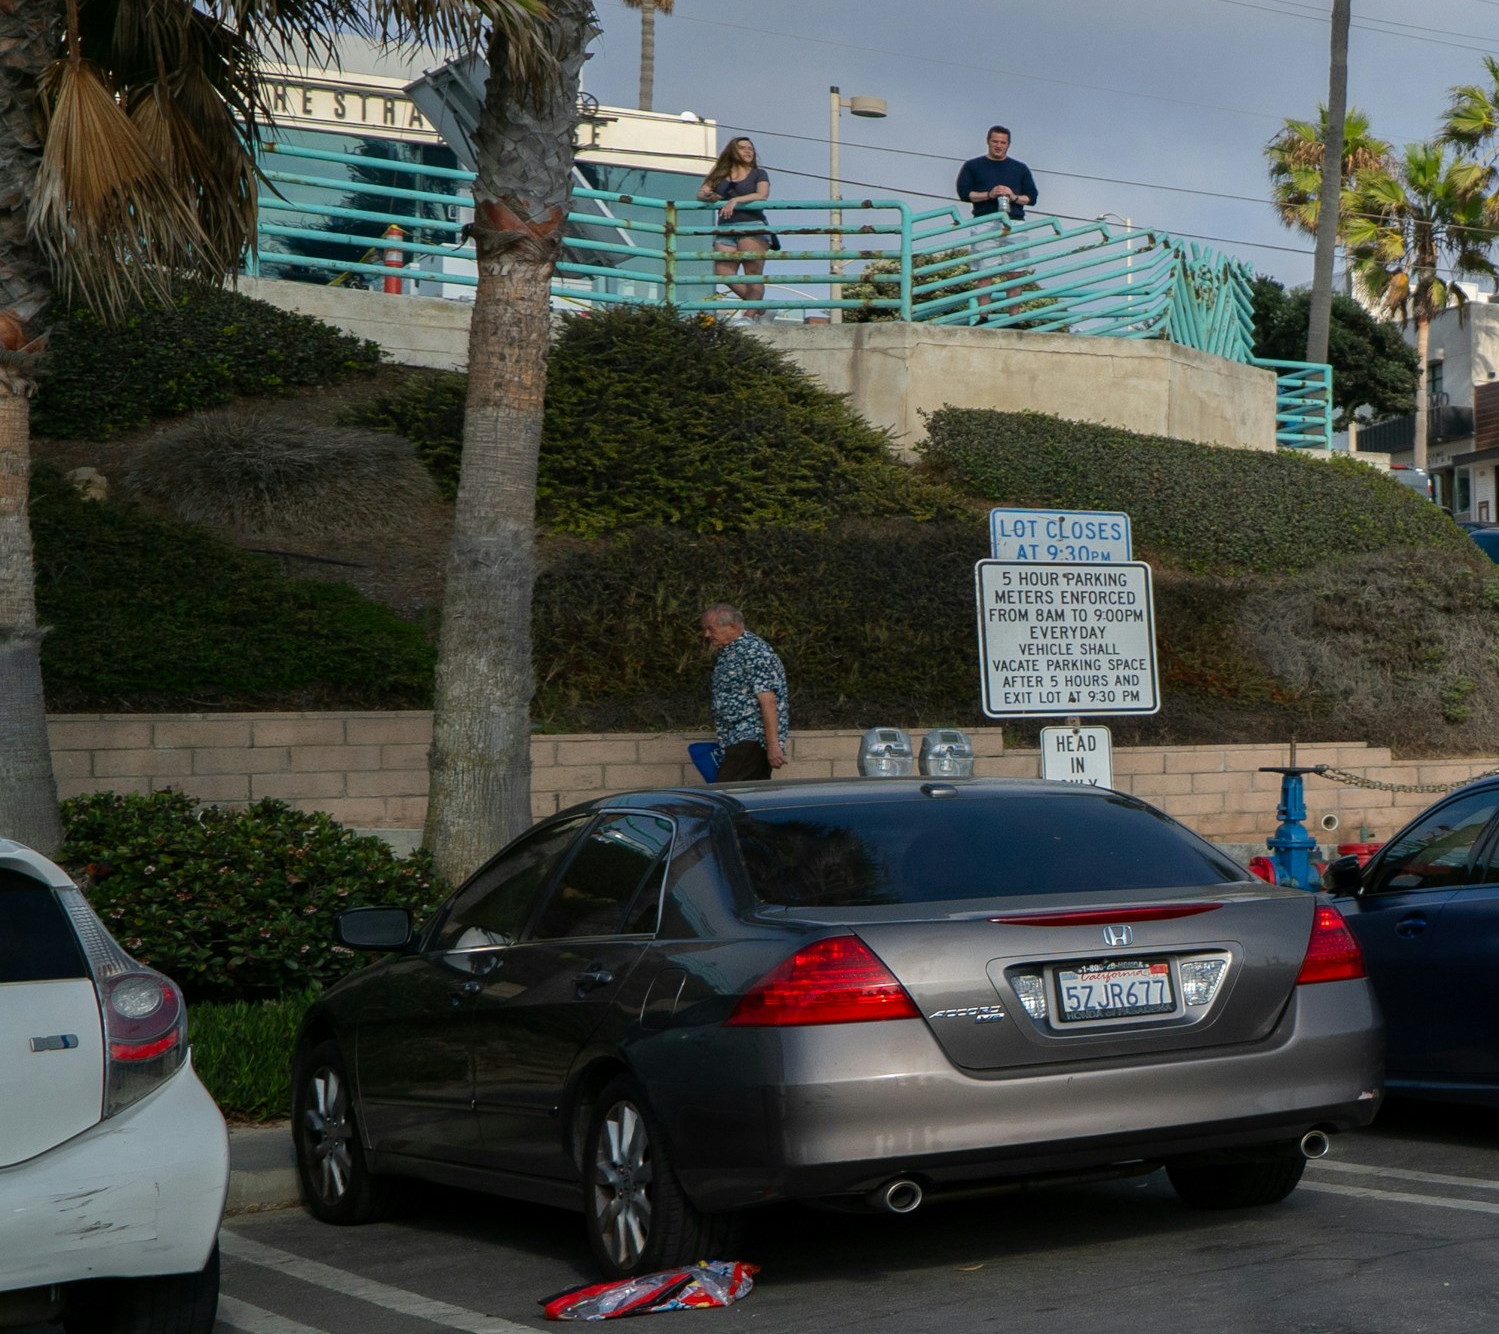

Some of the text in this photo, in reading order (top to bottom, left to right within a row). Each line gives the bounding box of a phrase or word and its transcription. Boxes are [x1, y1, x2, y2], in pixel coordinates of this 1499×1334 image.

[334, 90, 423, 128] STRA
[1000, 519, 1122, 540] LOT CLOSES
[1016, 544, 1039, 560] AT
[1002, 571, 1127, 587] 5 HOUR PARKING
[995, 590, 1136, 605] METERS ENFORCED
[989, 608, 1144, 622] FROM 8AM TO 9:00PM
[1030, 626, 1106, 640] EVERYDAY
[1019, 643, 1120, 656] VEHICLE SHALL
[992, 658, 1147, 672] VACATE PARKING SPACE
[1002, 674, 1140, 688] AFTER 5 HOURS AND
[1004, 690, 1140, 704] EXIT LOT AT 9:30 PM
[1056, 735, 1096, 752] HEAD
[1071, 757, 1085, 773] IN
[1080, 969, 1147, 983] California
[1065, 979, 1165, 1011] 5ZJR677
